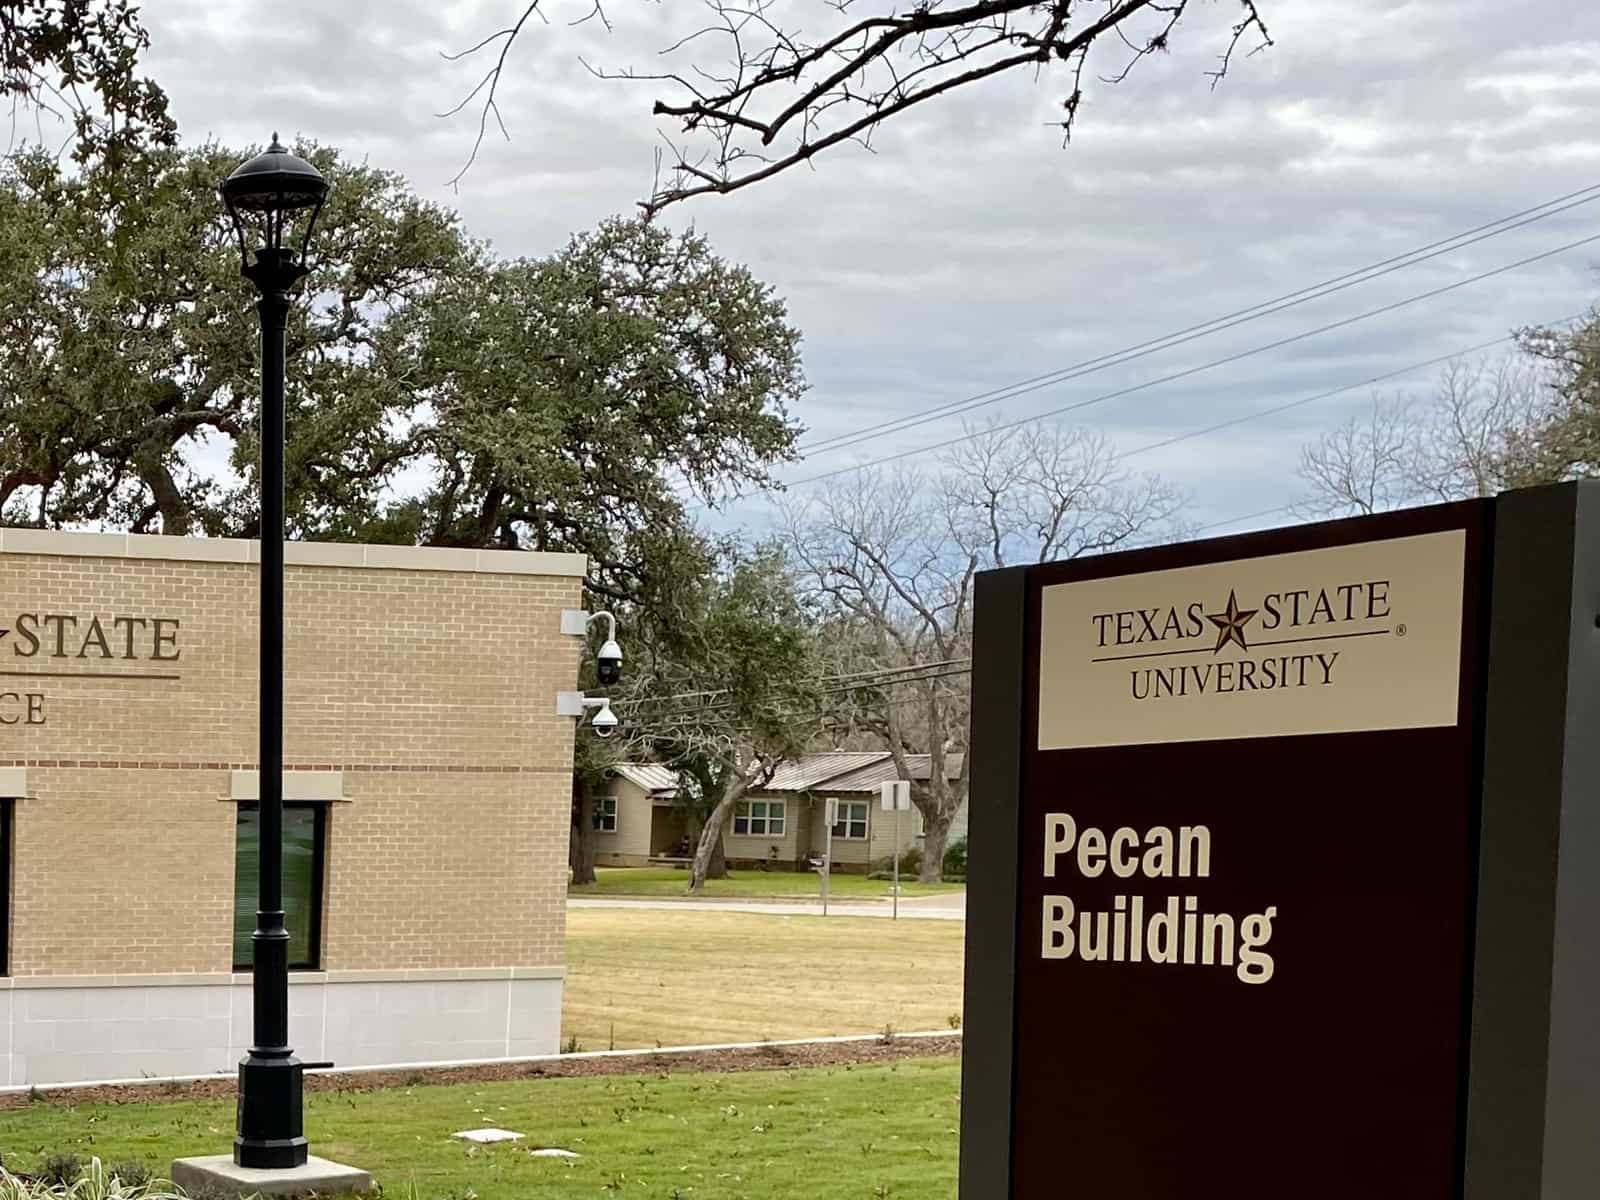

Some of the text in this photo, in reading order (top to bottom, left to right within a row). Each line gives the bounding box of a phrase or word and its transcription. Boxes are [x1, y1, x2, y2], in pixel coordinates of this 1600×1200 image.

[14, 613, 181, 661] STATE
[1092, 580, 1391, 648] TEXAS STATE
[1130, 652, 1340, 700] UNIVERSITY
[1043, 812, 1211, 878] Pecan
[1041, 894, 1277, 984] Building
